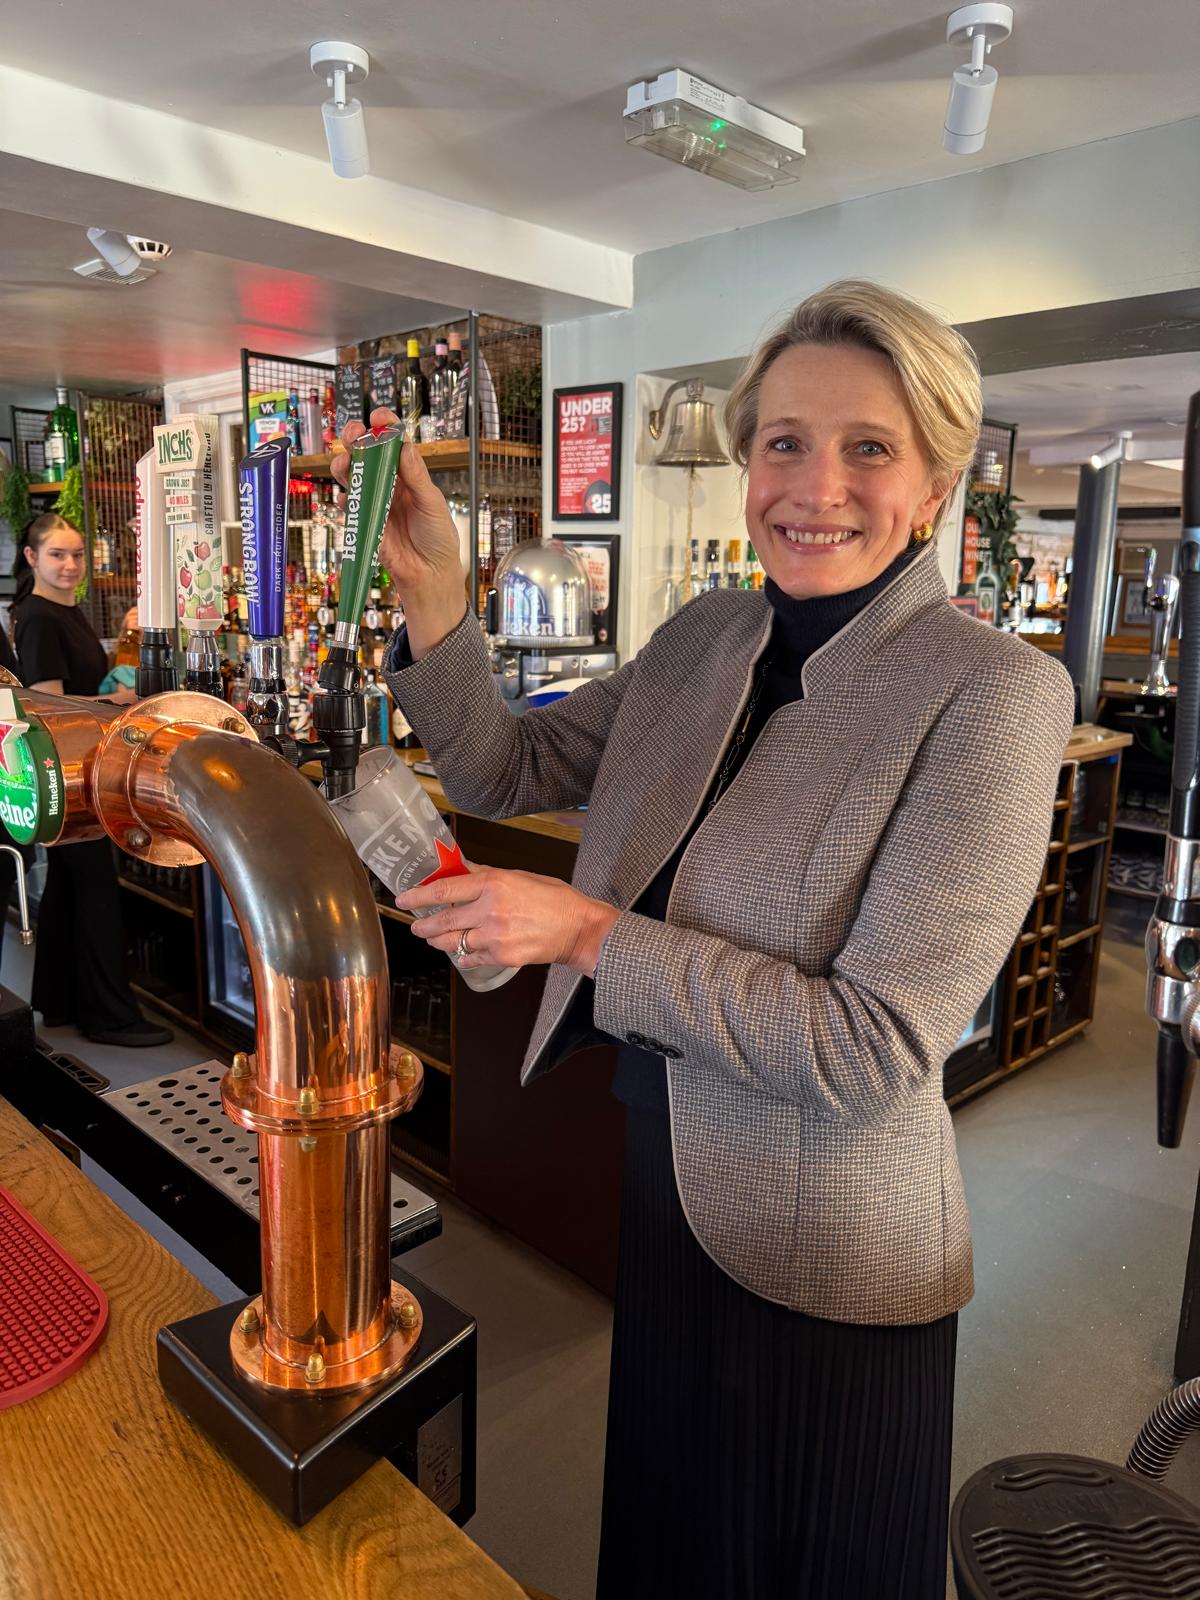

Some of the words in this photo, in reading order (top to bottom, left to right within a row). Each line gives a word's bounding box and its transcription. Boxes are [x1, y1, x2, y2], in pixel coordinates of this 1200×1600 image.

[260, 402, 275, 414] VK
[561, 397, 612, 417] UNDER
[561, 416, 586, 433] 25?
[157, 428, 192, 464] INCH'S
[176, 495, 189, 505] MILES
[203, 483, 213, 492] IN
[203, 494, 214, 535] CRAFTED
[342, 461, 365, 562] Heineken
[591, 493, 611, 513] 25
[275, 503, 283, 532] CIDER
[239, 482, 260, 604] STRONGBOW
[275, 534, 283, 563] FRUIT
[965, 537, 990, 549] HOUSE
[274, 565, 282, 593] DARK
[46, 770, 58, 816] Heineken
[0, 793, 37, 830] eine
